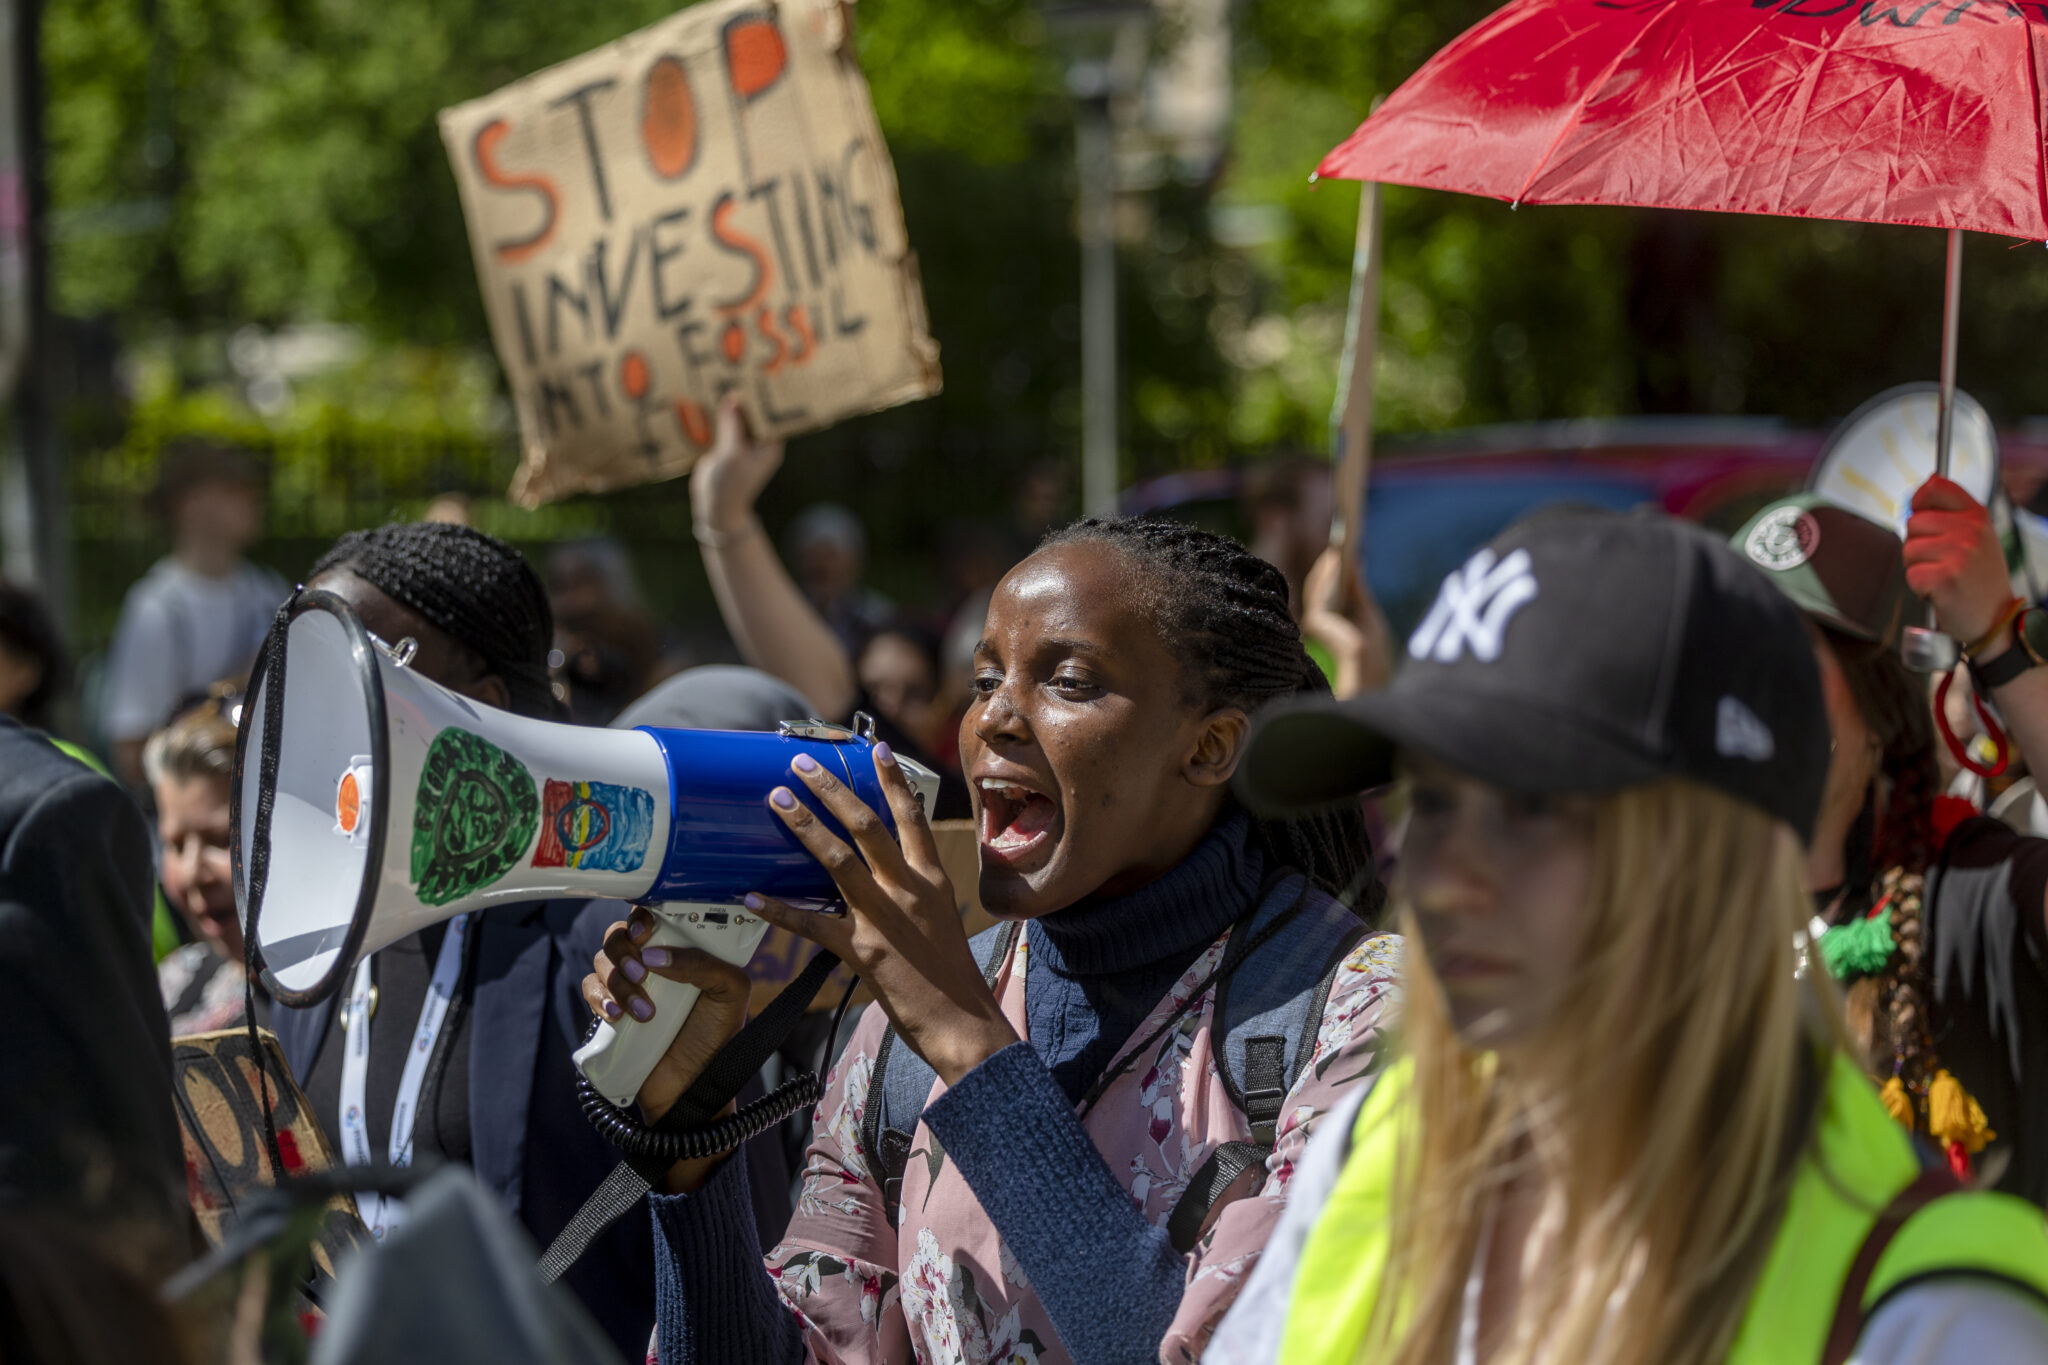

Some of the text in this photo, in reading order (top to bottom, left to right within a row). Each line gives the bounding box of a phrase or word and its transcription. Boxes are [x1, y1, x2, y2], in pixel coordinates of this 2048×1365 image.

[473, 9, 788, 264] STOP
[511, 138, 879, 366] INVESTING
[677, 284, 868, 392] FOSSIL
[1408, 547, 1538, 663] NY
